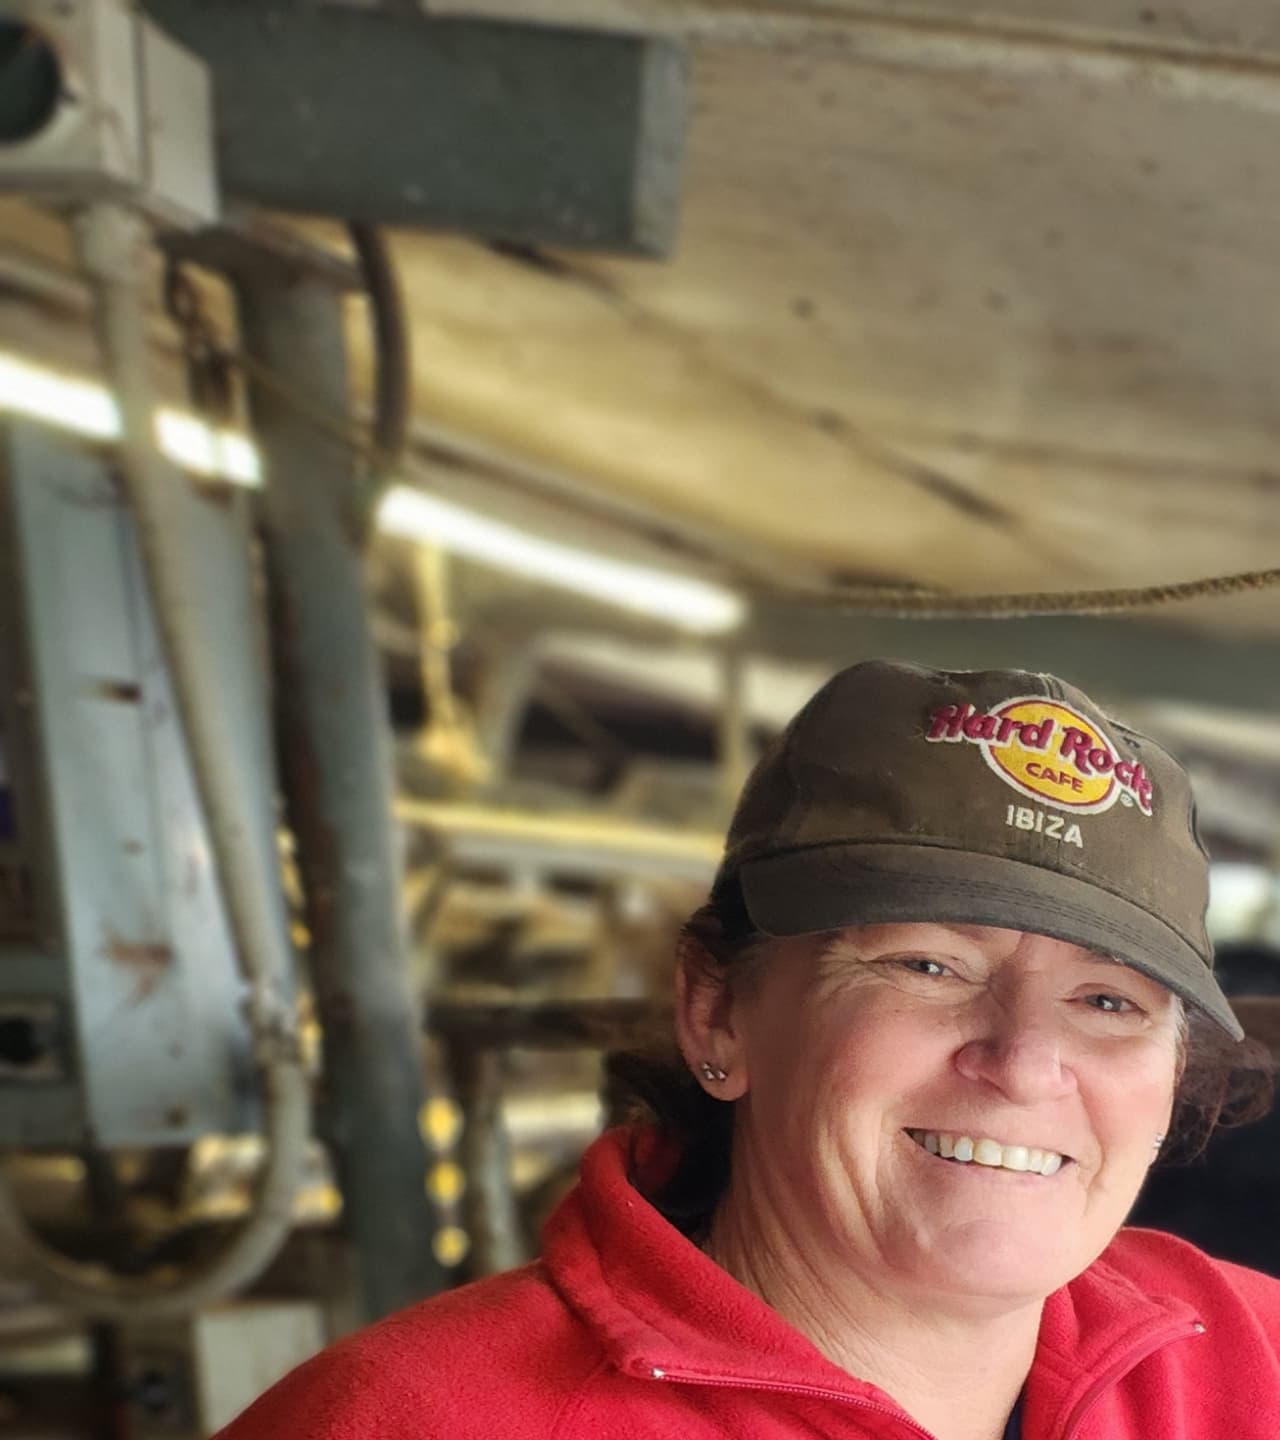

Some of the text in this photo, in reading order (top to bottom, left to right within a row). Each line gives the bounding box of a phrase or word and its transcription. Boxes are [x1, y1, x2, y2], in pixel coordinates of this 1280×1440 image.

[926, 704, 1152, 814] Hard Rock
[1026, 762, 1083, 793] CAFE
[1006, 804, 1083, 848] IBIZA
